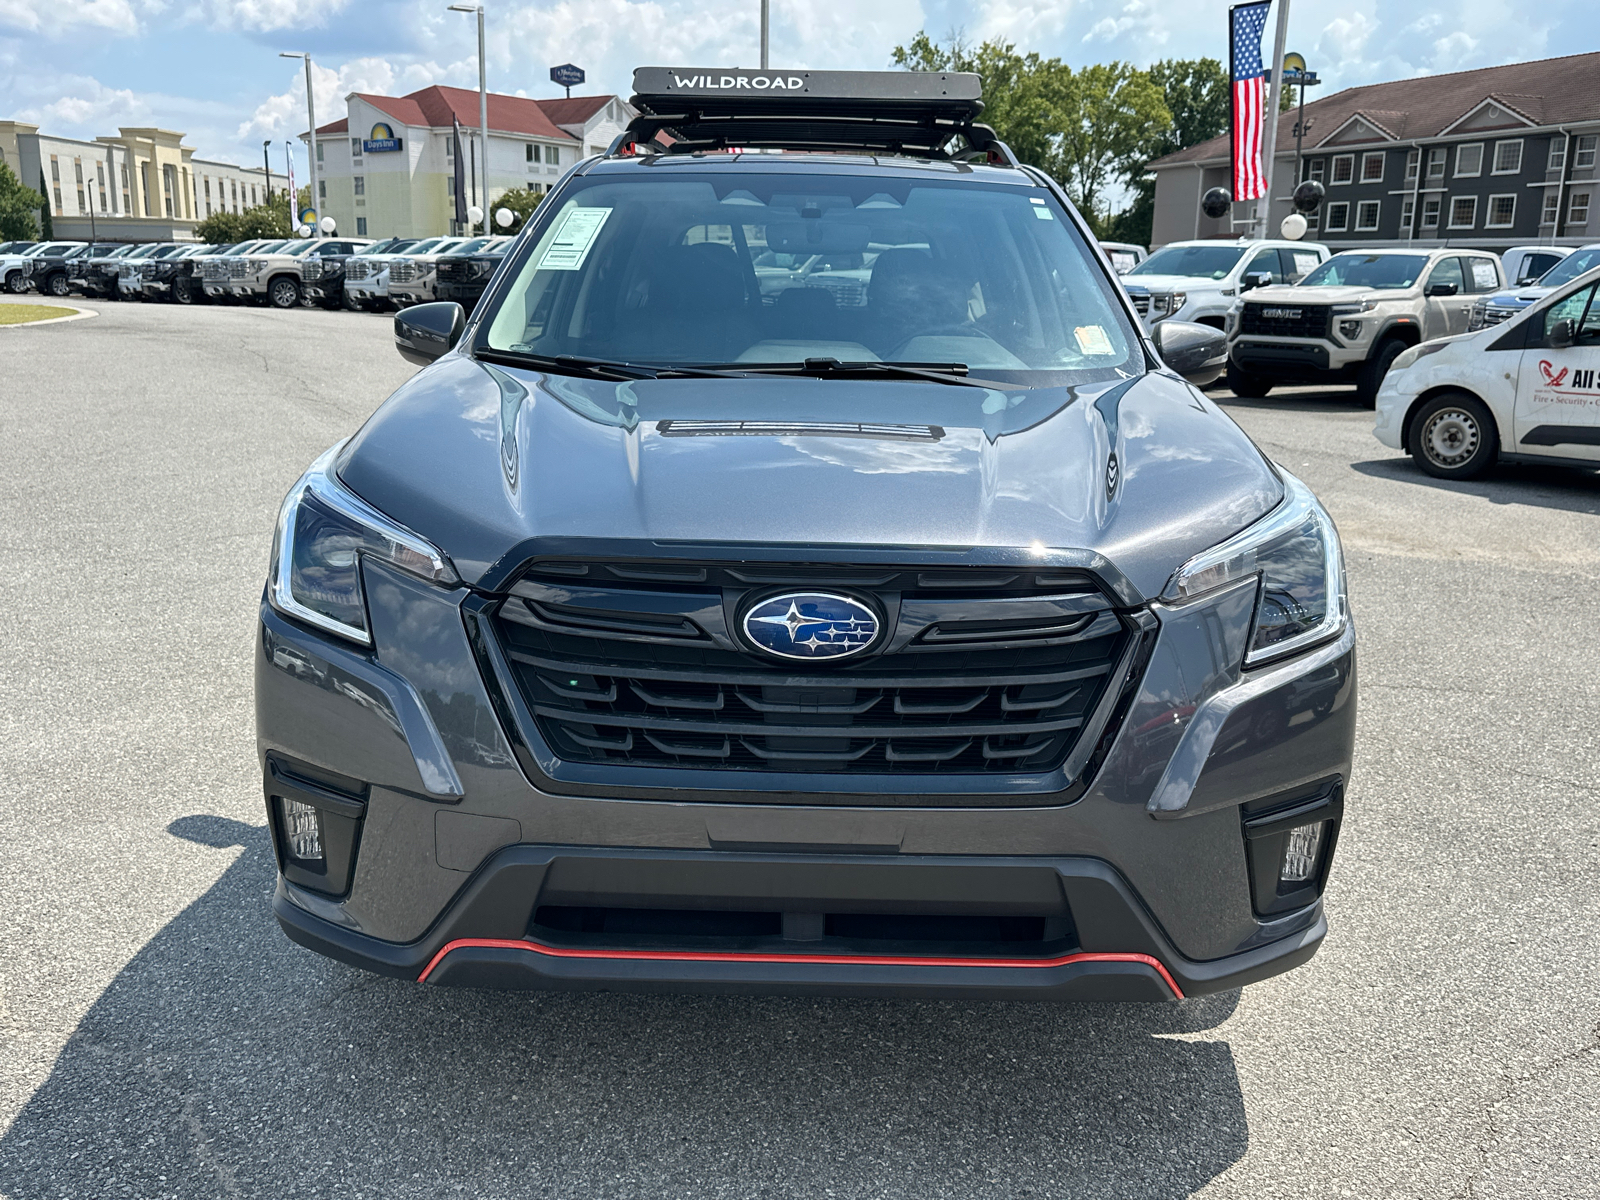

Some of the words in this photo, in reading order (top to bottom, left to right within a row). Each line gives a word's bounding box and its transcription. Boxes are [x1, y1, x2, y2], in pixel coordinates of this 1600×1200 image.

[674, 75, 804, 90] WILDROAD
[367, 141, 383, 149] Days
[383, 140, 394, 148] Inn
[1262, 308, 1303, 319] GMC
[1571, 369, 1594, 389] All
[1533, 394, 1549, 403] Fire
[1555, 395, 1588, 408] Security
